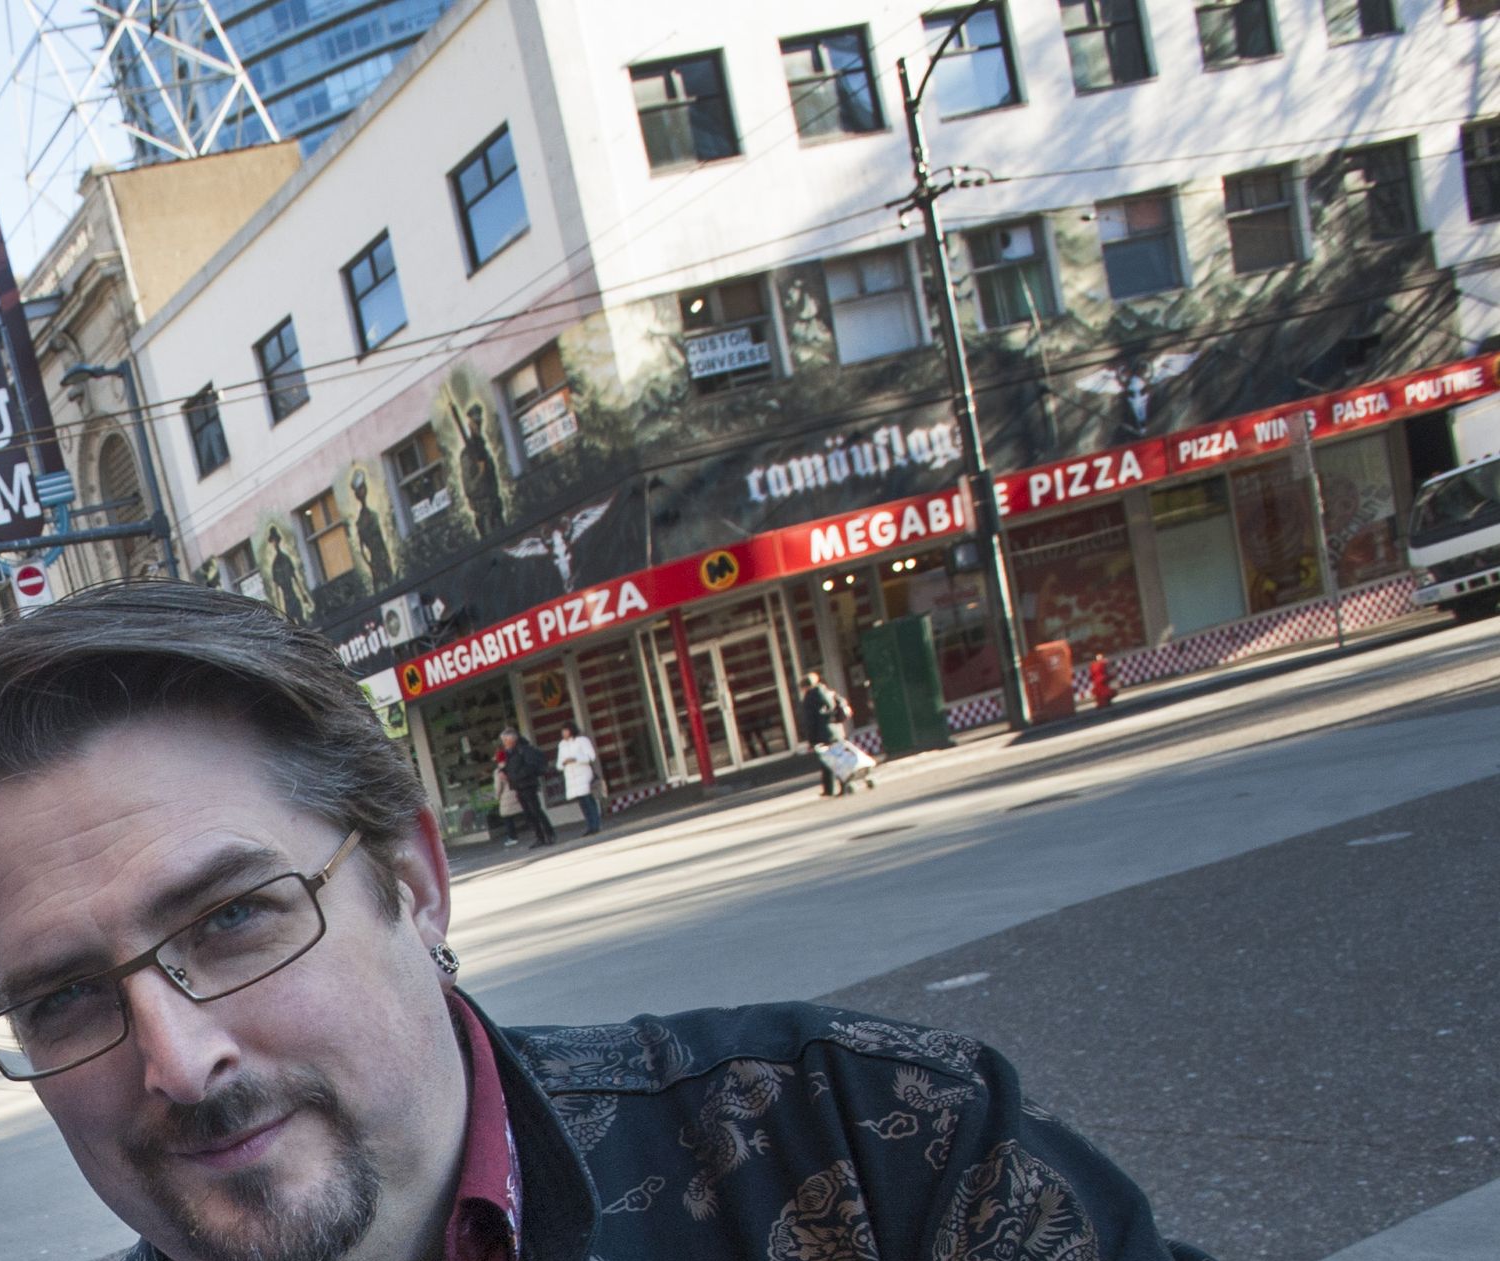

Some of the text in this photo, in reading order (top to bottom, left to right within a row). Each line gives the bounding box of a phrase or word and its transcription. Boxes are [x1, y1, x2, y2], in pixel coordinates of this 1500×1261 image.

[1179, 367, 1484, 463] PIZZA WINS PASTA POUTINE
[810, 482, 1011, 565] MEGABIE
[1029, 449, 1144, 508] PIZZA
[424, 618, 534, 688] MEGABITE
[537, 581, 649, 642] PIZZA
